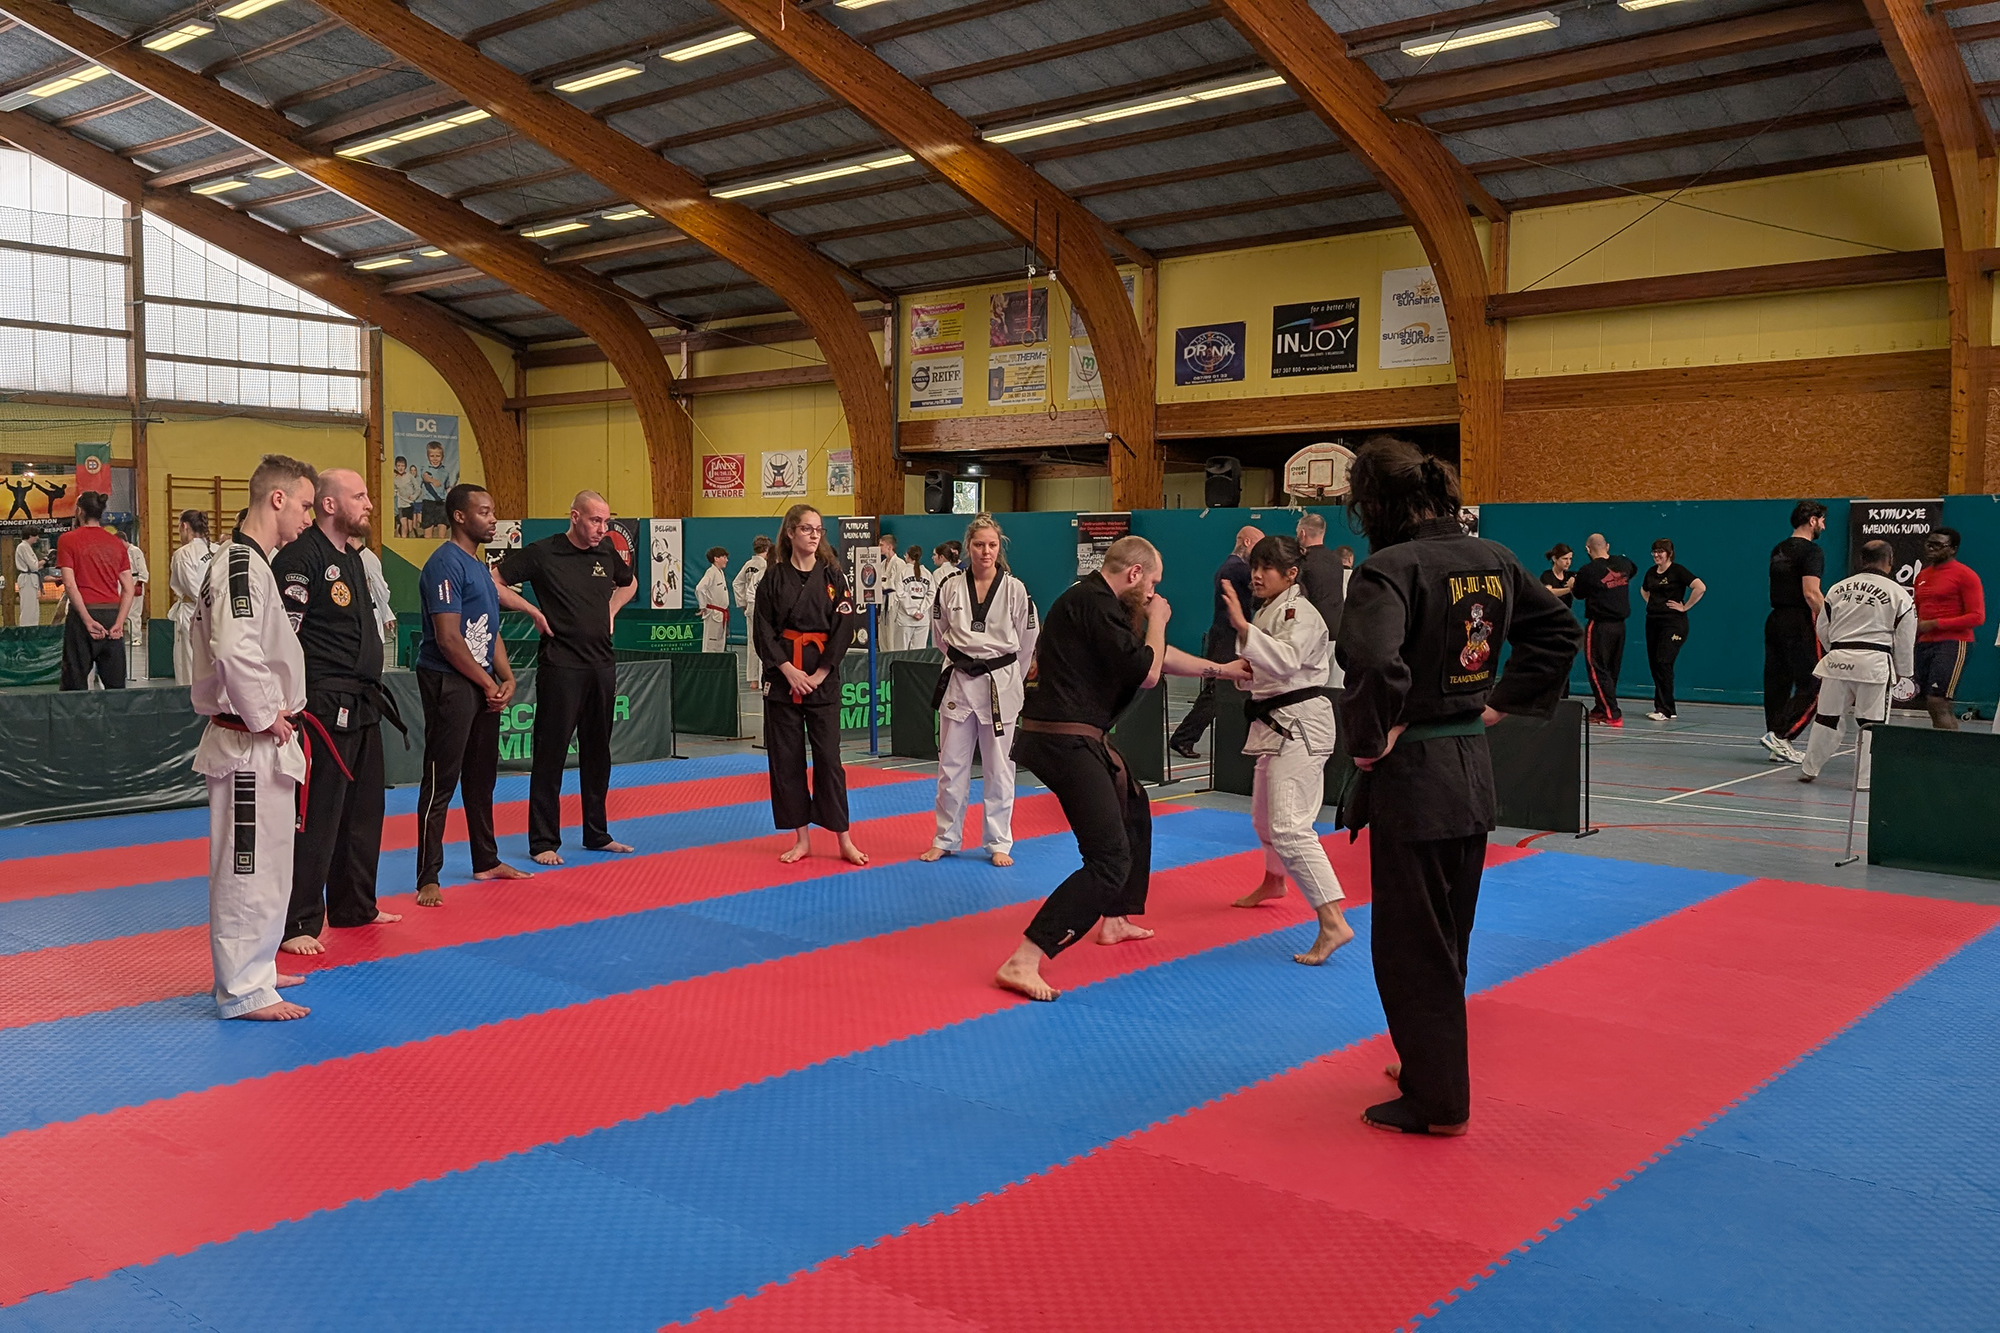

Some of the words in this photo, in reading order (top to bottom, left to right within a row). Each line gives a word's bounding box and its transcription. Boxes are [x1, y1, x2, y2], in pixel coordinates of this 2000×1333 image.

[1393, 290, 1414, 300] radio
[1345, 302, 1355, 310] life
[1398, 296, 1440, 306] sunshine
[1382, 329, 1423, 340] sunshine
[1400, 334, 1435, 345] sounds
[1276, 328, 1354, 354] INJOY
[416, 418, 437, 432] DG
[1868, 508, 1926, 519] KIMUYE
[654, 525, 677, 533] BELGIUM
[1862, 524, 1900, 534] HAEDONG
[1901, 524, 1930, 534] KUMDO
[1834, 582, 1891, 605] TAEKWONDO
[651, 624, 693, 640] JOOLA
